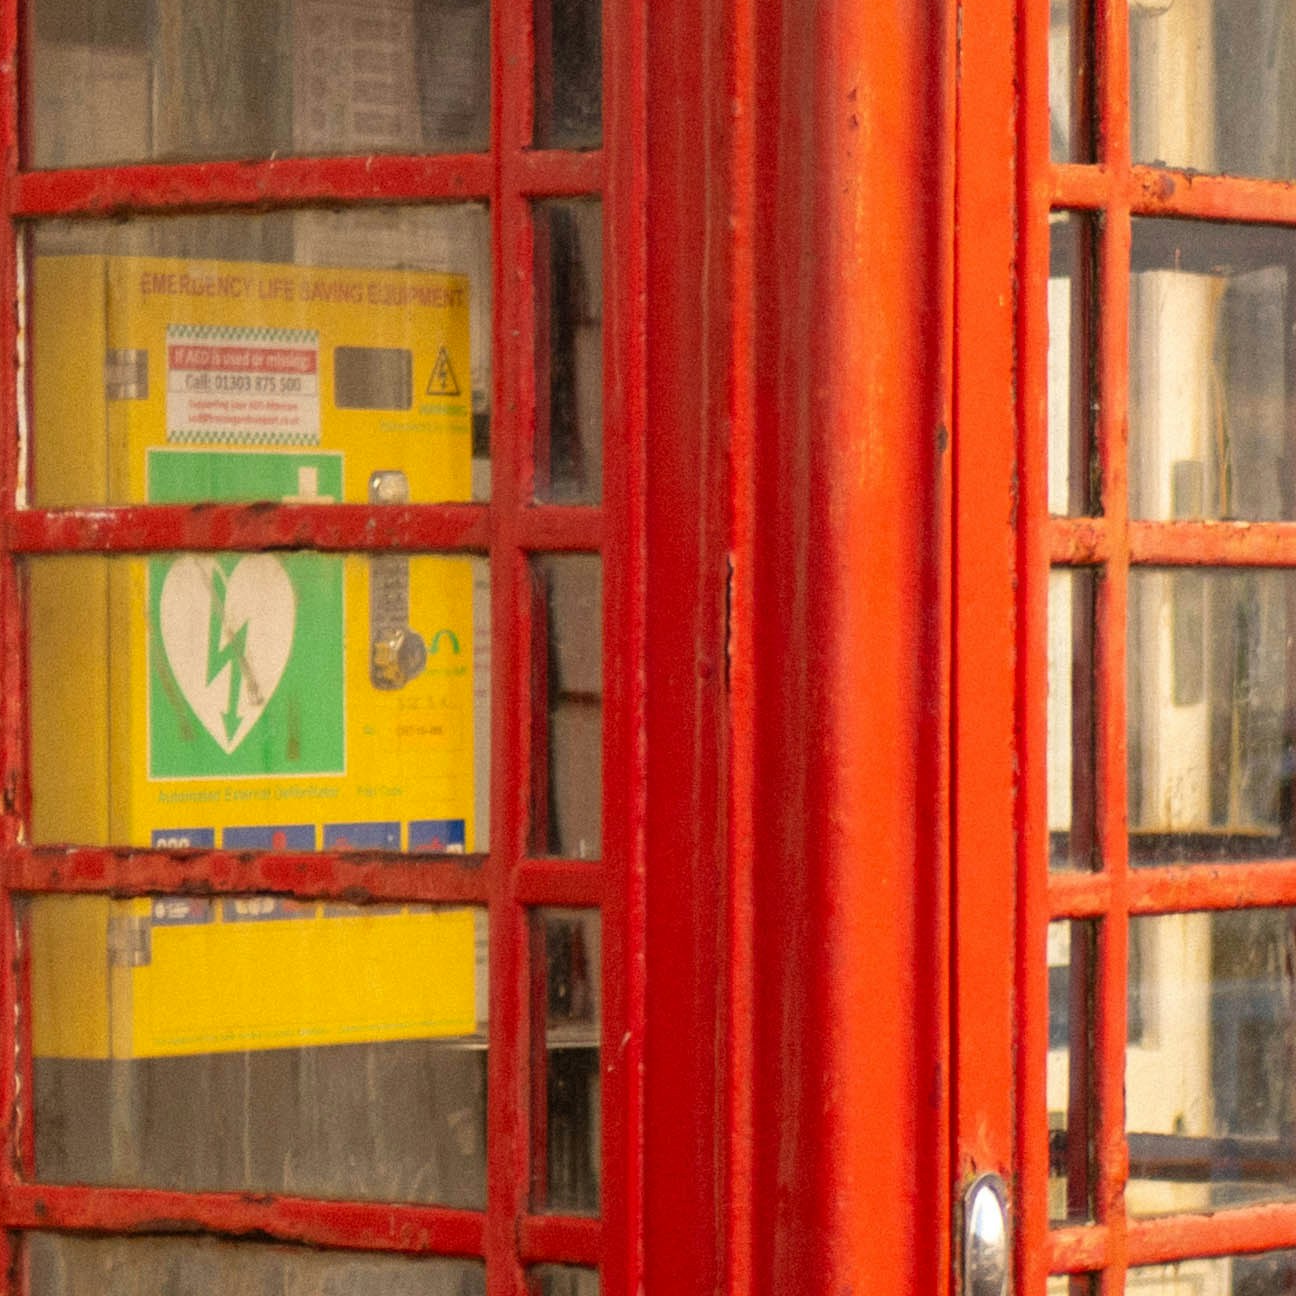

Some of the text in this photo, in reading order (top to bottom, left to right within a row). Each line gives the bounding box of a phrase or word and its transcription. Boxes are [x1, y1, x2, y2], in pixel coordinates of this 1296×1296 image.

[141, 271, 465, 308] EMERGENCY LIFE SAVING EQUIPMENT
[185, 373, 211, 391] Call:
